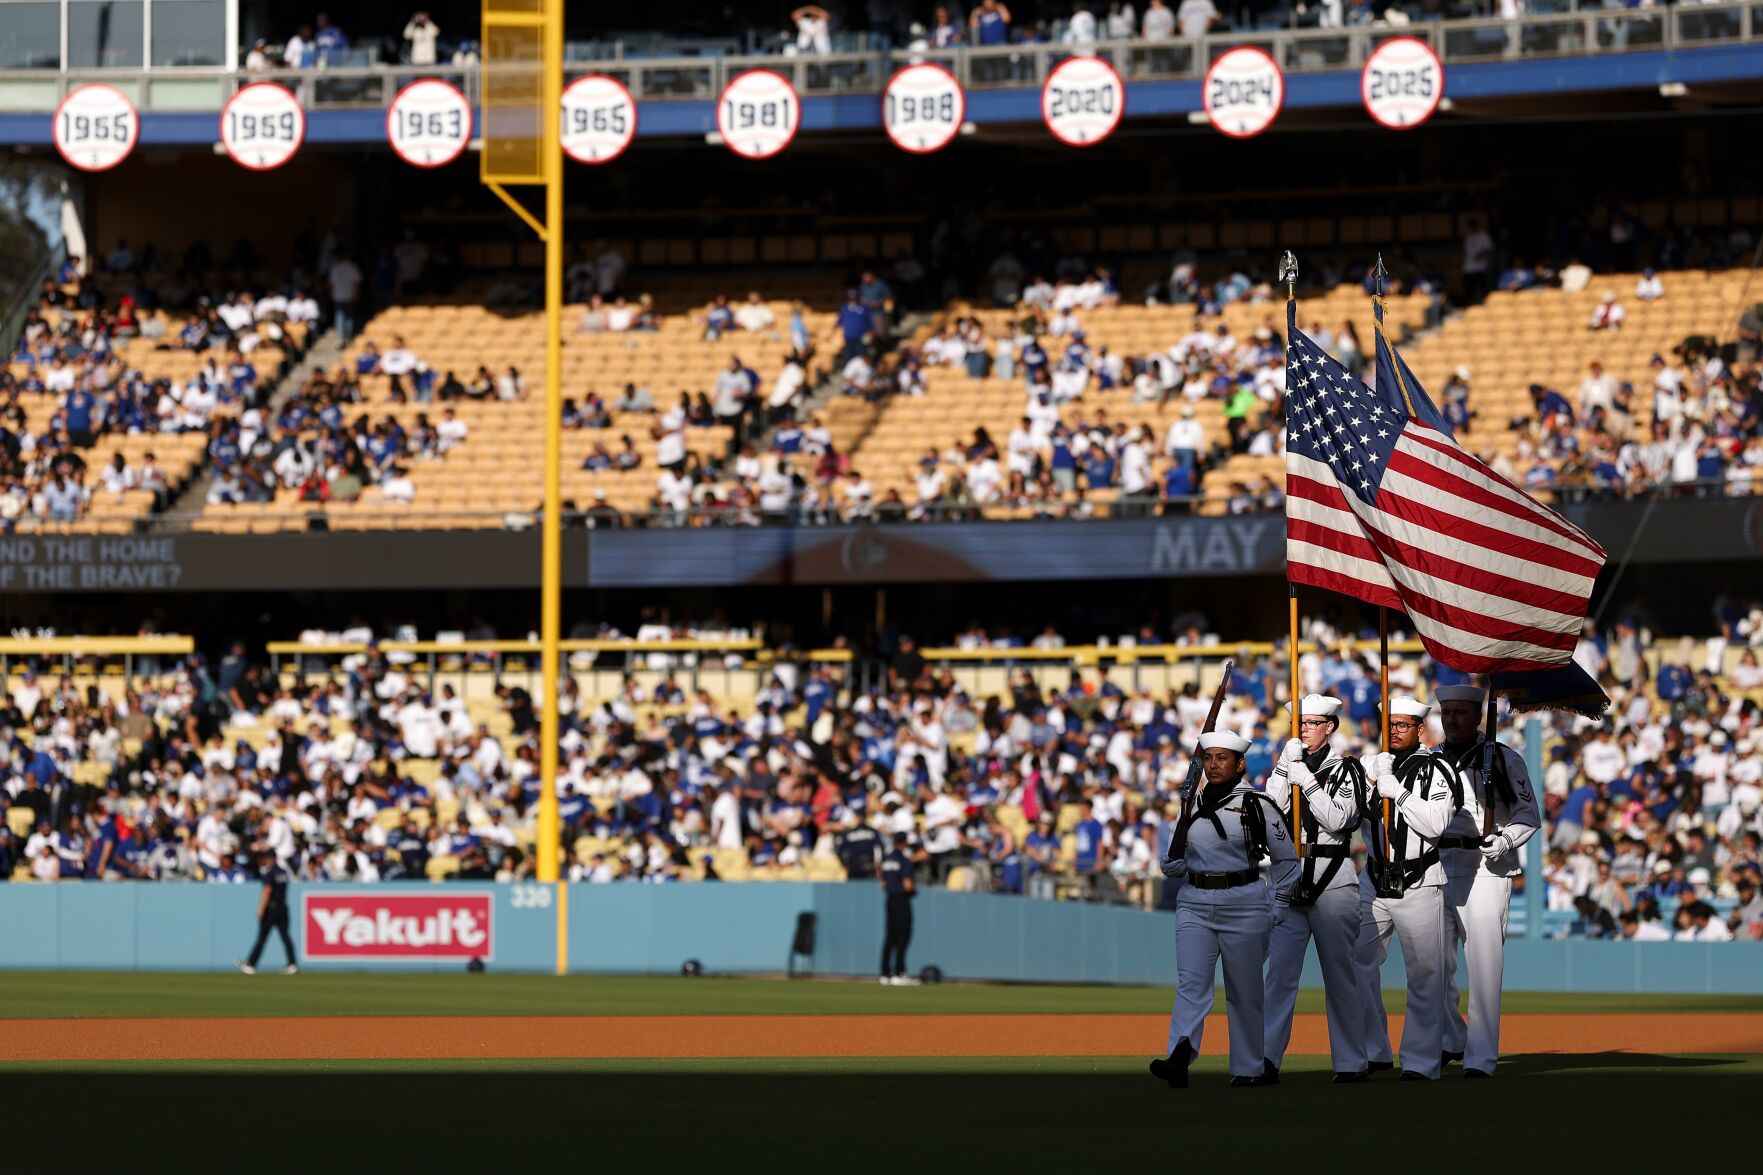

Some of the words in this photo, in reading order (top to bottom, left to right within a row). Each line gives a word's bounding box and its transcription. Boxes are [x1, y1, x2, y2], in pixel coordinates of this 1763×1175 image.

[1212, 74, 1273, 109] 2024
[1371, 66, 1433, 99] 2025
[726, 98, 789, 131] 1981
[888, 92, 953, 126] 1988
[1052, 84, 1114, 118] 2020
[63, 111, 129, 143] 1955
[230, 111, 294, 142] 1959
[397, 108, 461, 140] 1963
[560, 103, 626, 136] 1965
[42, 538, 92, 562] THE
[101, 537, 175, 562] HOME
[1152, 522, 1266, 570] MAY
[24, 564, 73, 588] THE
[80, 564, 183, 588] BRAVE?
[510, 885, 553, 908] 330
[310, 907, 487, 948] Yakult
